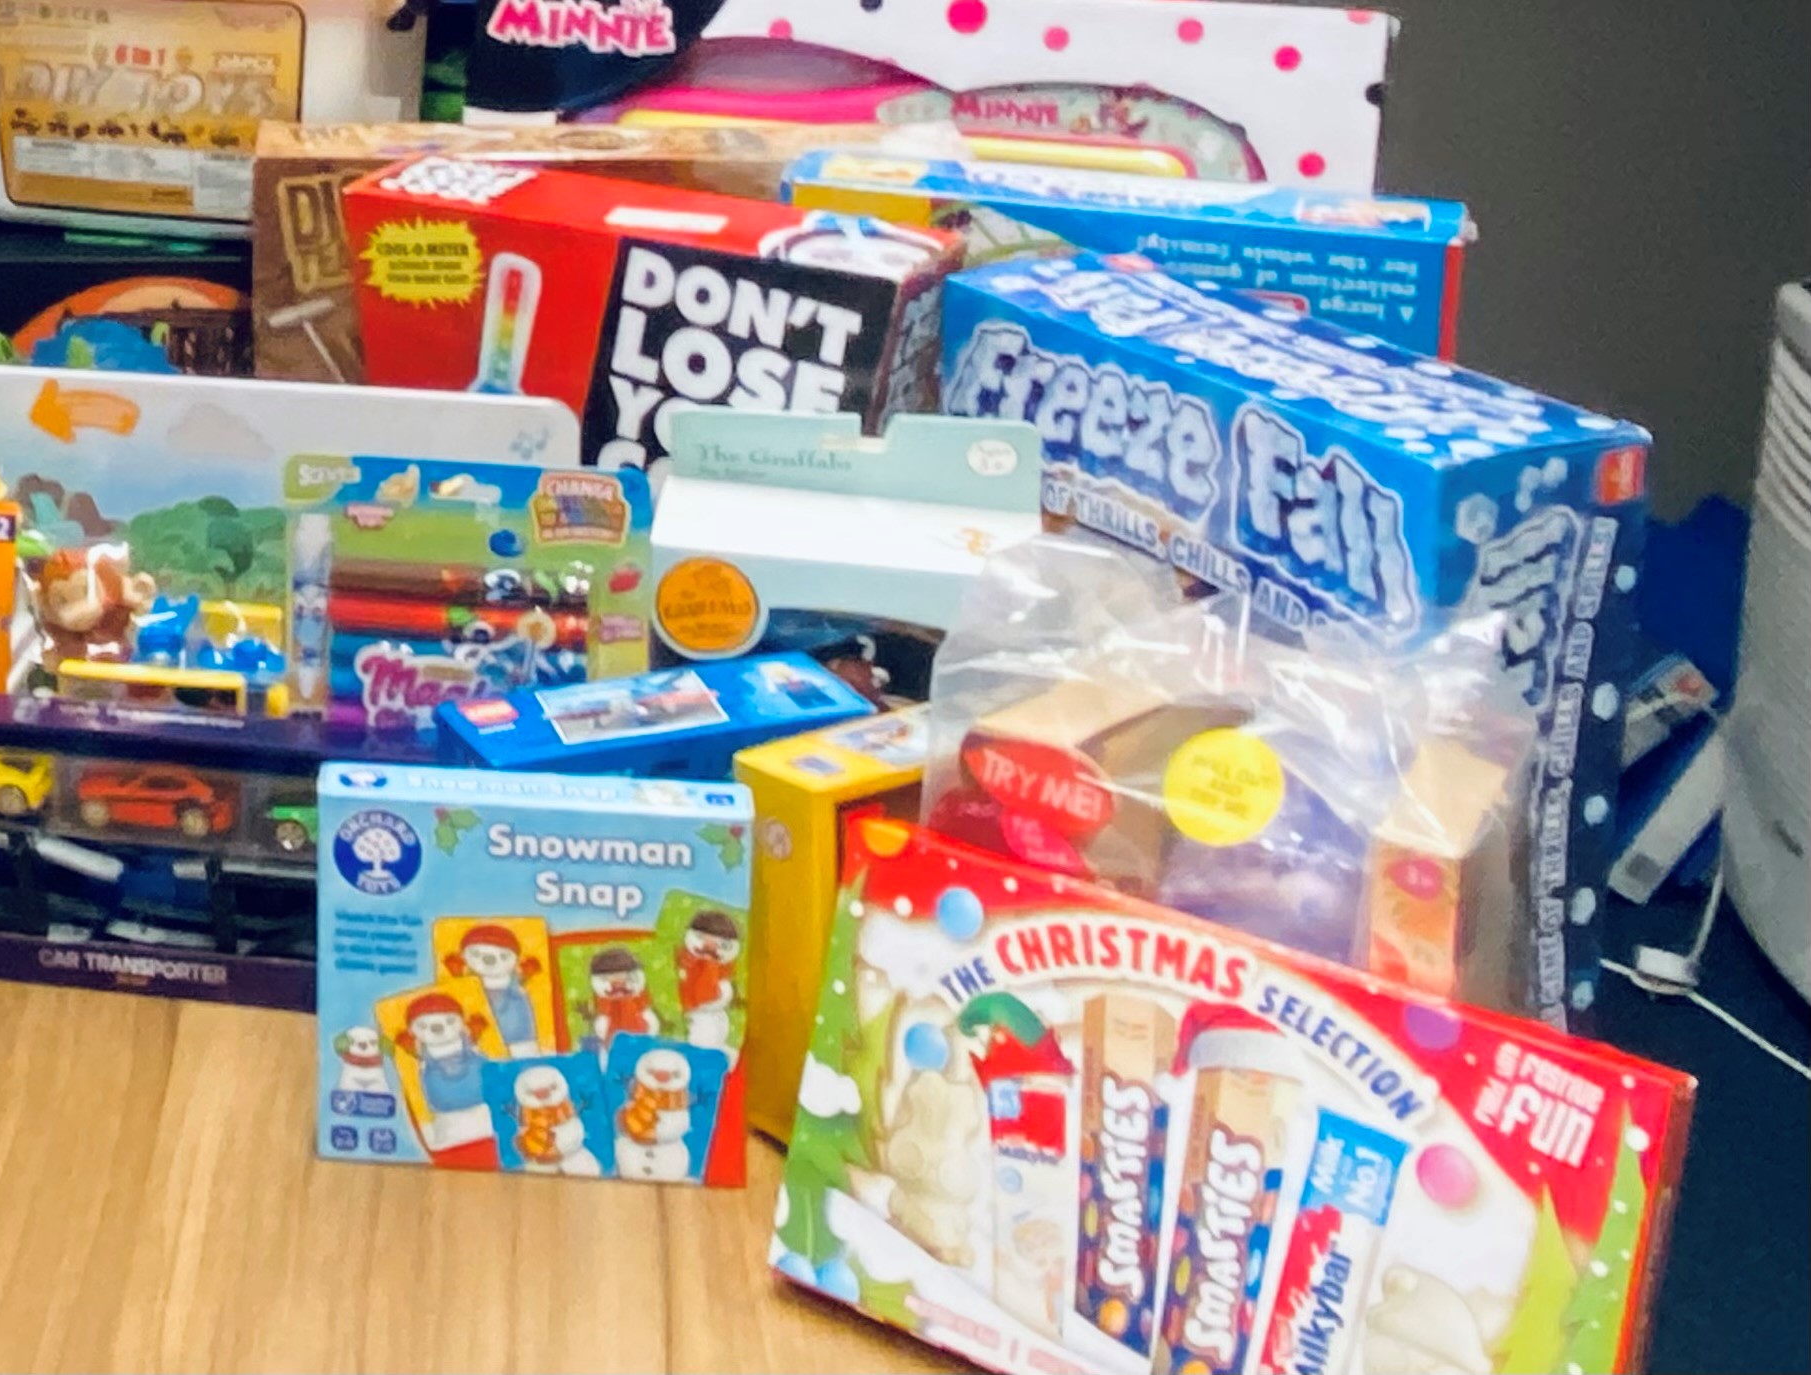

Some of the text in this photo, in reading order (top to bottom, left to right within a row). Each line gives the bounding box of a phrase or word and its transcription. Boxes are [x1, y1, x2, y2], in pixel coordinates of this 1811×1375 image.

[621, 245, 862, 366] DON'T
[612, 307, 845, 413] LOSE
[982, 747, 1103, 822] TRY ME!
[488, 824, 692, 868] Snowman
[536, 871, 643, 917] Snap
[38, 947, 228, 985] CAR TRANSPORTER
[941, 955, 996, 1005] THE
[995, 923, 1246, 999] CHRISTMAS
[1257, 984, 1424, 1122] SELECTION
